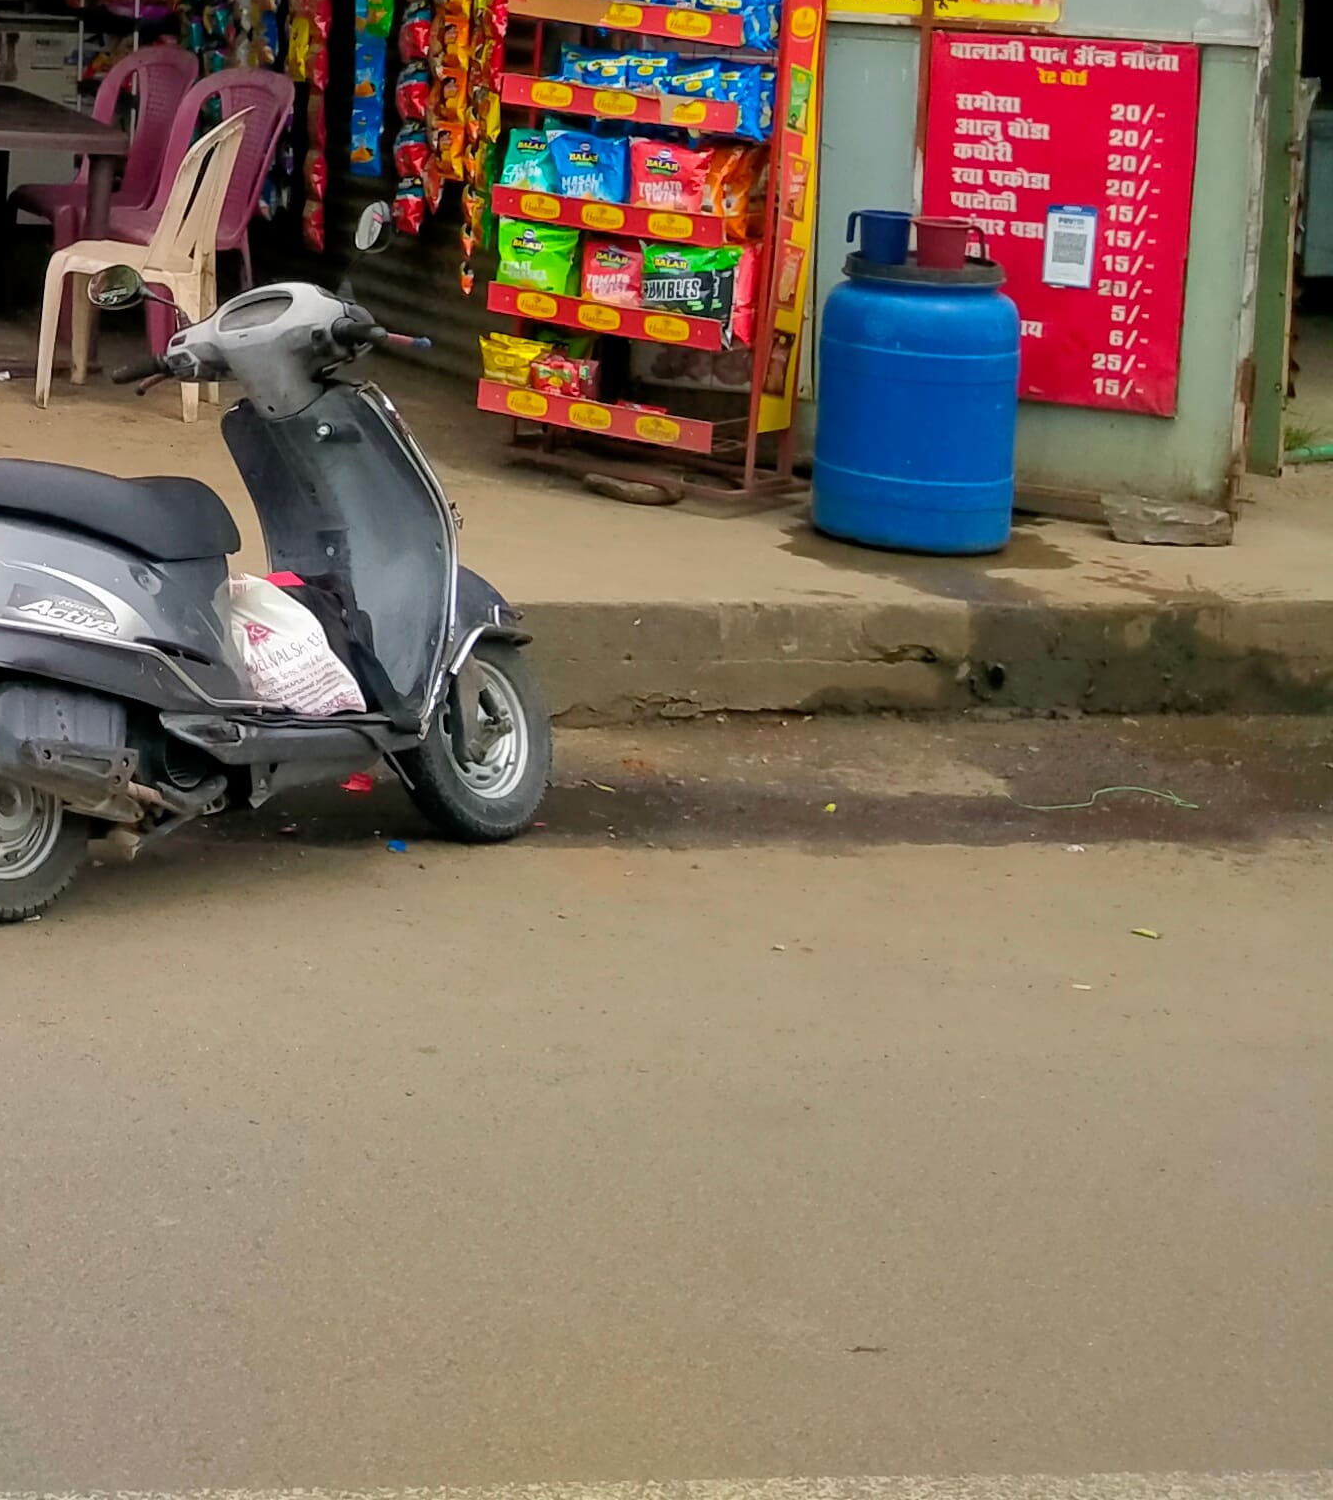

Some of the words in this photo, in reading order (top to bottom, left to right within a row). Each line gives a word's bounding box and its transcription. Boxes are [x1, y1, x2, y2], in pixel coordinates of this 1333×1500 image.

[949, 40, 1025, 63] बालाजी
[1030, 44, 1068, 66] पान
[955, 90, 1021, 114] समोसा
[1110, 103, 1165, 125] 20/-
[954, 117, 1004, 142] आलु
[1007, 117, 1051, 141] बोंडा
[1108, 128, 1164, 150] 20/-
[952, 140, 1014, 163] कचोरी
[1106, 153, 1162, 175] 20/-
[951, 166, 983, 185] रवा
[988, 166, 1051, 190] पकोडा
[1105, 178, 1161, 201] 20/-
[1105, 204, 1159, 226] 15/-
[1103, 228, 1157, 251] 15/-
[1101, 254, 1155, 276] 15/-
[1096, 278, 1153, 301] 20/-
[1110, 303, 1151, 325] 5/-
[1108, 328, 1149, 350] 6/-
[1091, 352, 1147, 375] 25/-
[1092, 377, 1145, 399] 15/-
[18, 598, 120, 636] Activa
